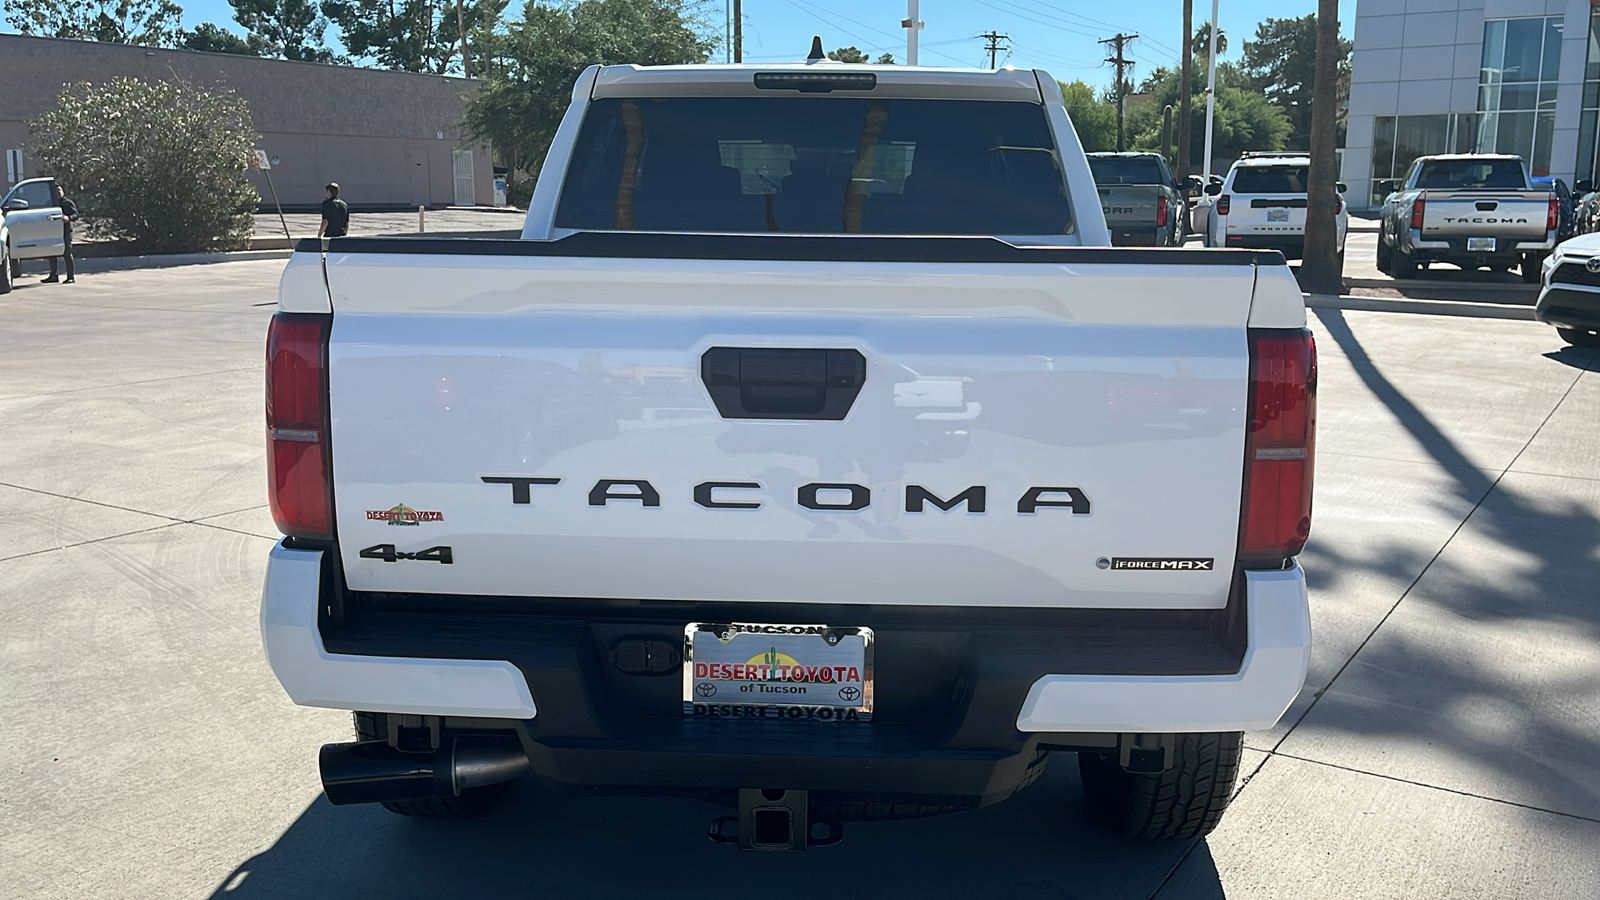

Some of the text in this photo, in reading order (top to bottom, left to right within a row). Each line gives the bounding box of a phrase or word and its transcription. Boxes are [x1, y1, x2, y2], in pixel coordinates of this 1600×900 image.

[480, 477, 1092, 514] TACOMA
[366, 510, 445, 521] DESERT TOYOTA
[360, 543, 453, 564] 4x4
[733, 624, 824, 635] TUCSON
[695, 663, 861, 683] DESERT TOYOTA
[739, 683, 807, 694] of Tucson
[693, 704, 860, 721] DESERT TOYOTA
